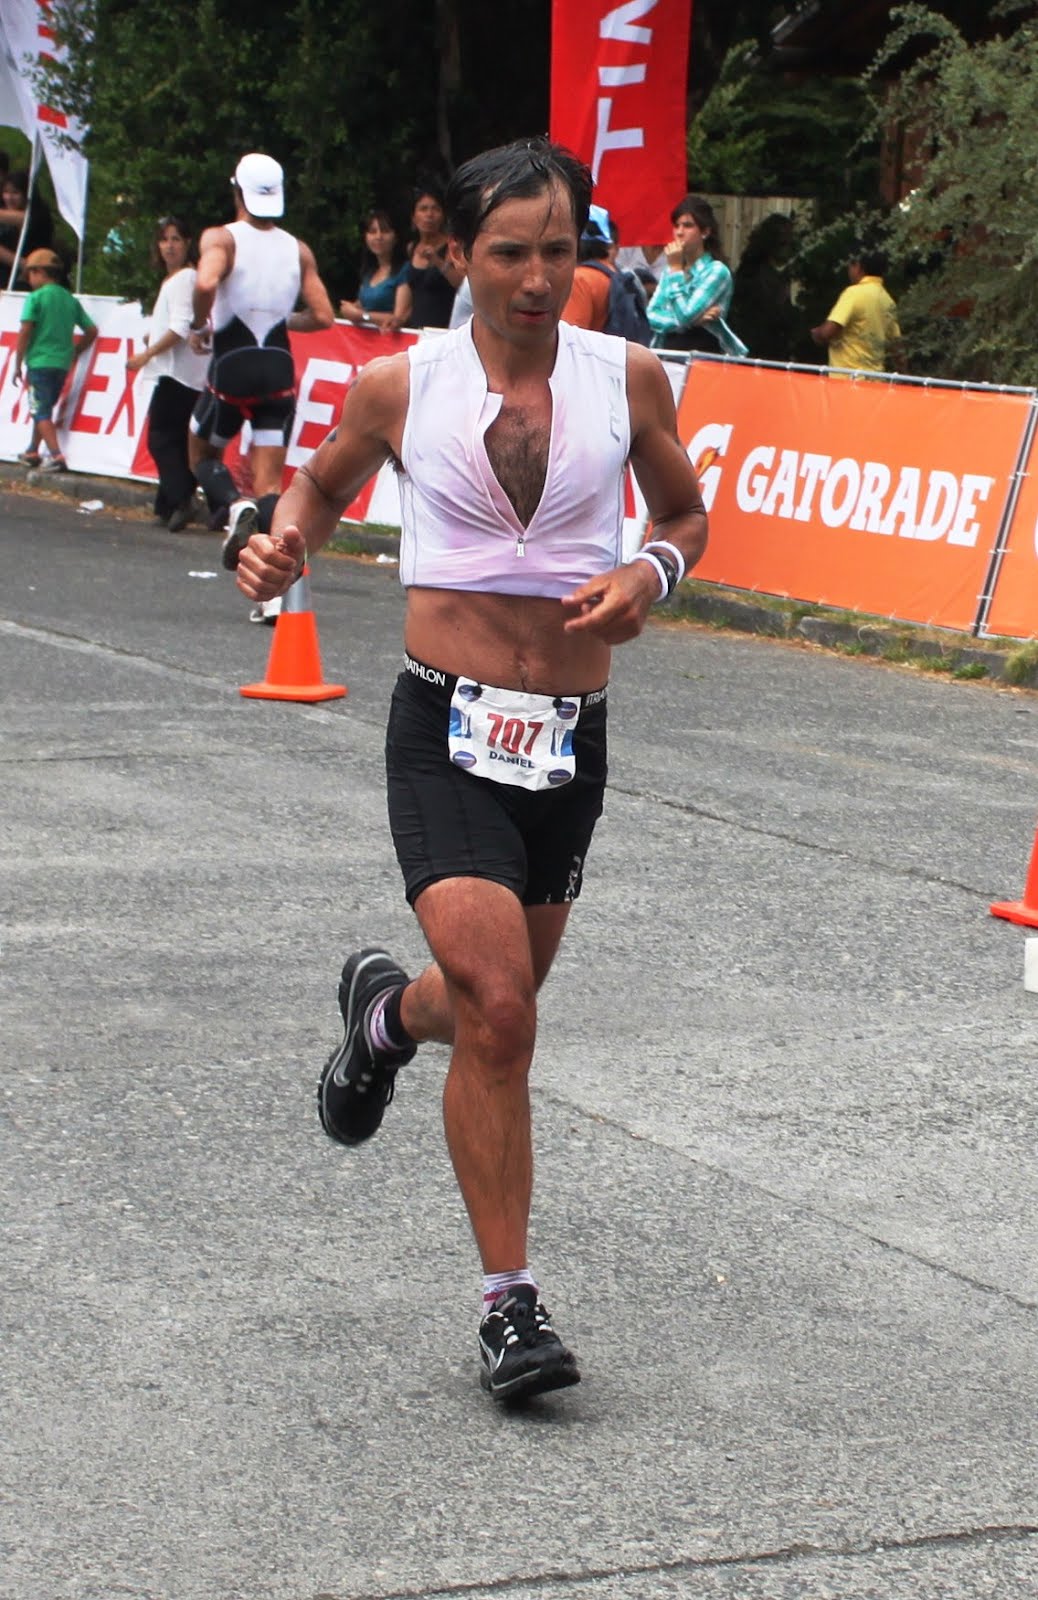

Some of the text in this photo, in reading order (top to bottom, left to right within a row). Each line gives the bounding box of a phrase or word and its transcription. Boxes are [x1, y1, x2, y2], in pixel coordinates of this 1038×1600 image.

[736, 446, 995, 547] GATORADE
[486, 712, 544, 756] 707
[489, 751, 535, 769] DANIEL
